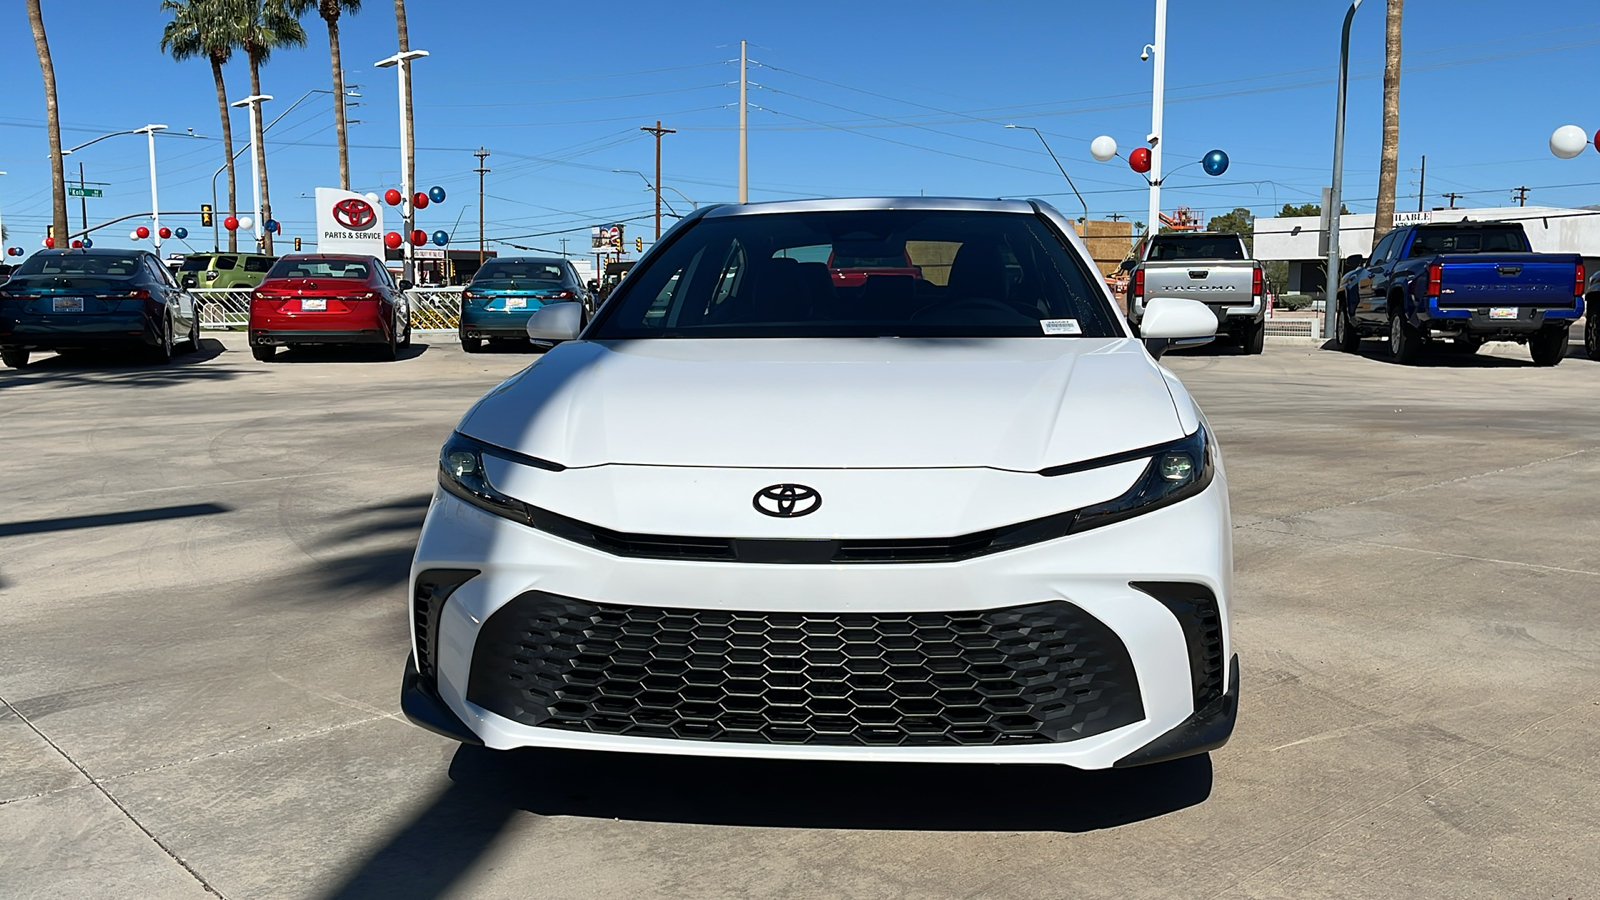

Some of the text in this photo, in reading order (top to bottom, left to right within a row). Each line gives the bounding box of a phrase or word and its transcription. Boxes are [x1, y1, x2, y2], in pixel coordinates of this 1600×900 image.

[324, 231, 381, 240] PARTS & SERVICE
